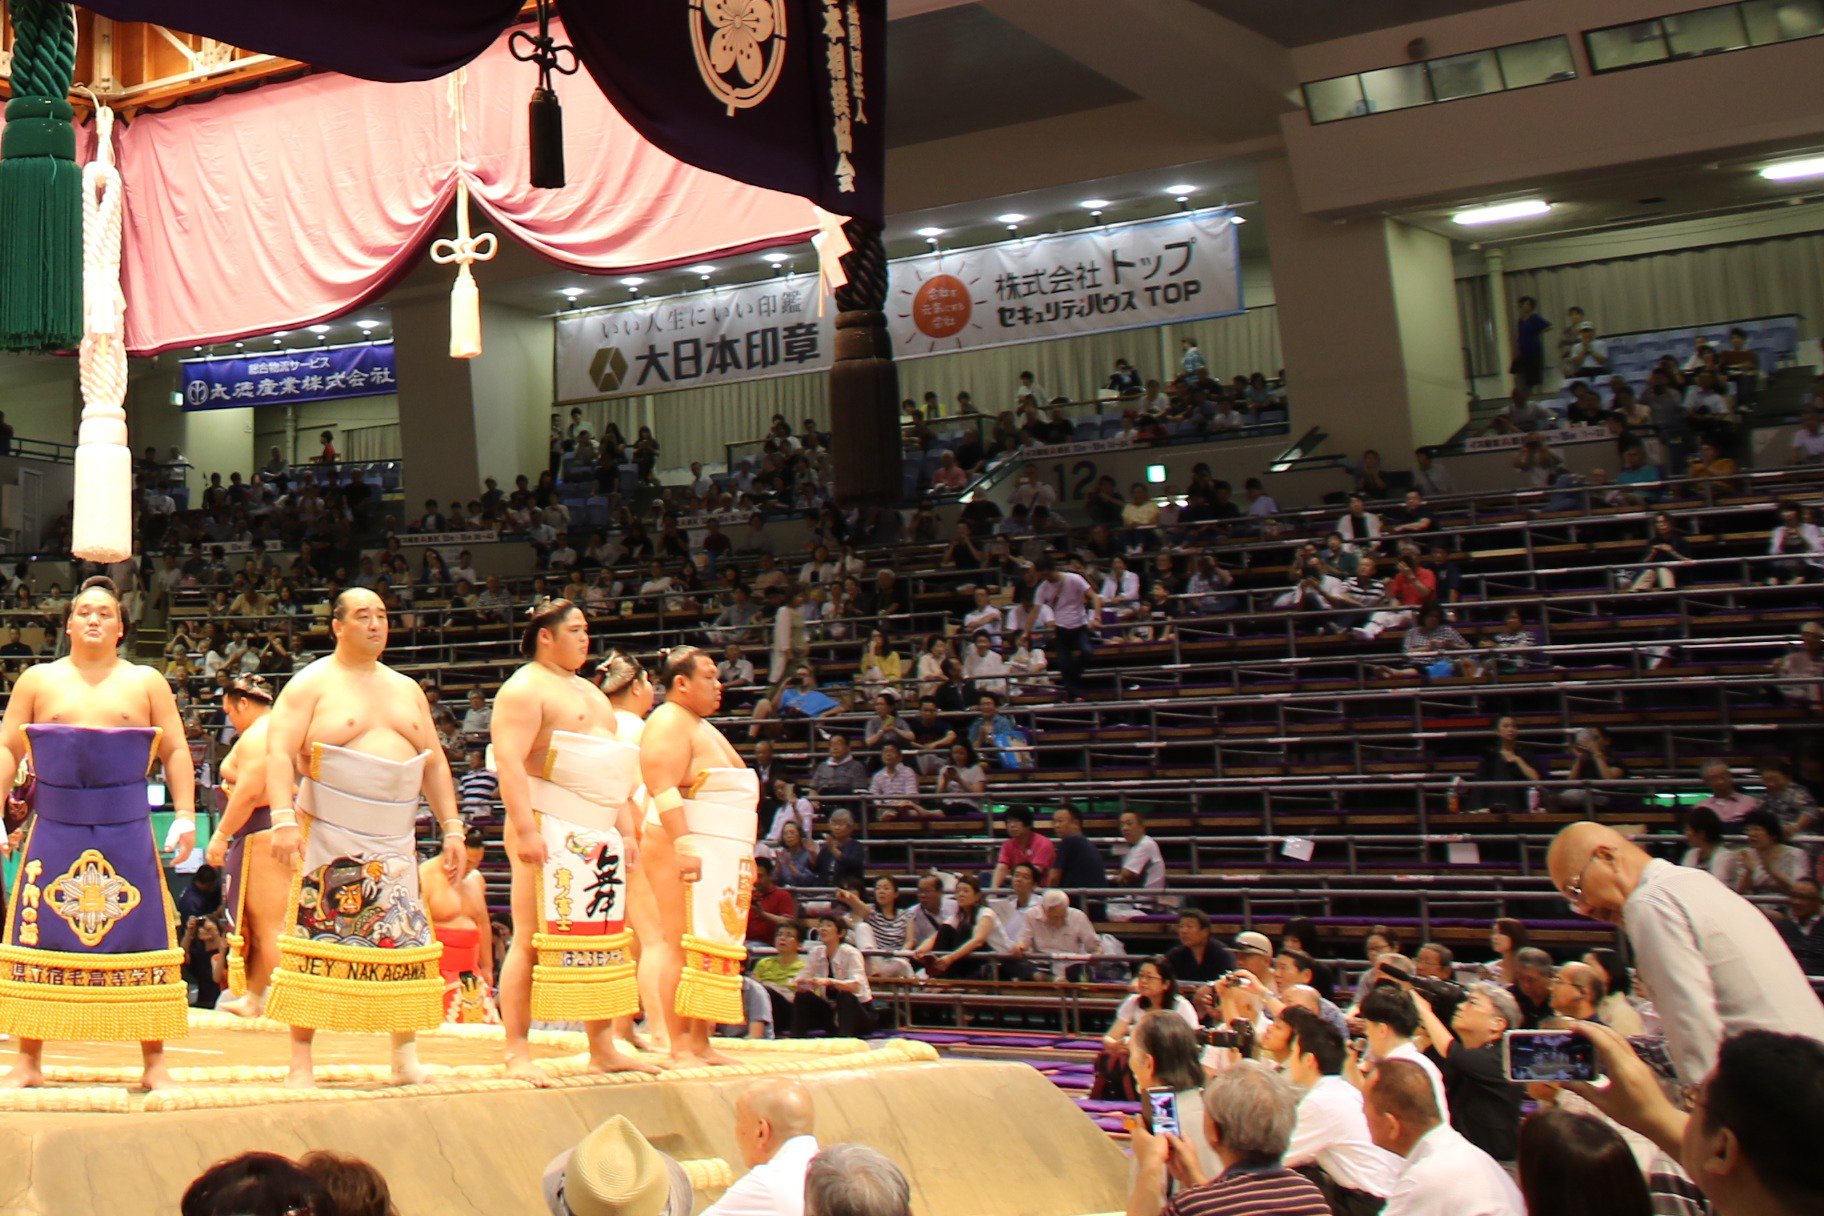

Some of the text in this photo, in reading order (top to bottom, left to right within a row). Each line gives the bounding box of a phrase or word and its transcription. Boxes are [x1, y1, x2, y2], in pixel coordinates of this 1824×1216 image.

[995, 236, 1198, 301] 株式会社 トップ
[600, 290, 803, 339] いい人生にいい印鑑
[997, 279, 1202, 328] セキュリティハウス TOP
[634, 321, 821, 386] 大日本印章
[1054, 460, 1098, 502] 12
[298, 955, 427, 981] JEY NAKAGAWA
